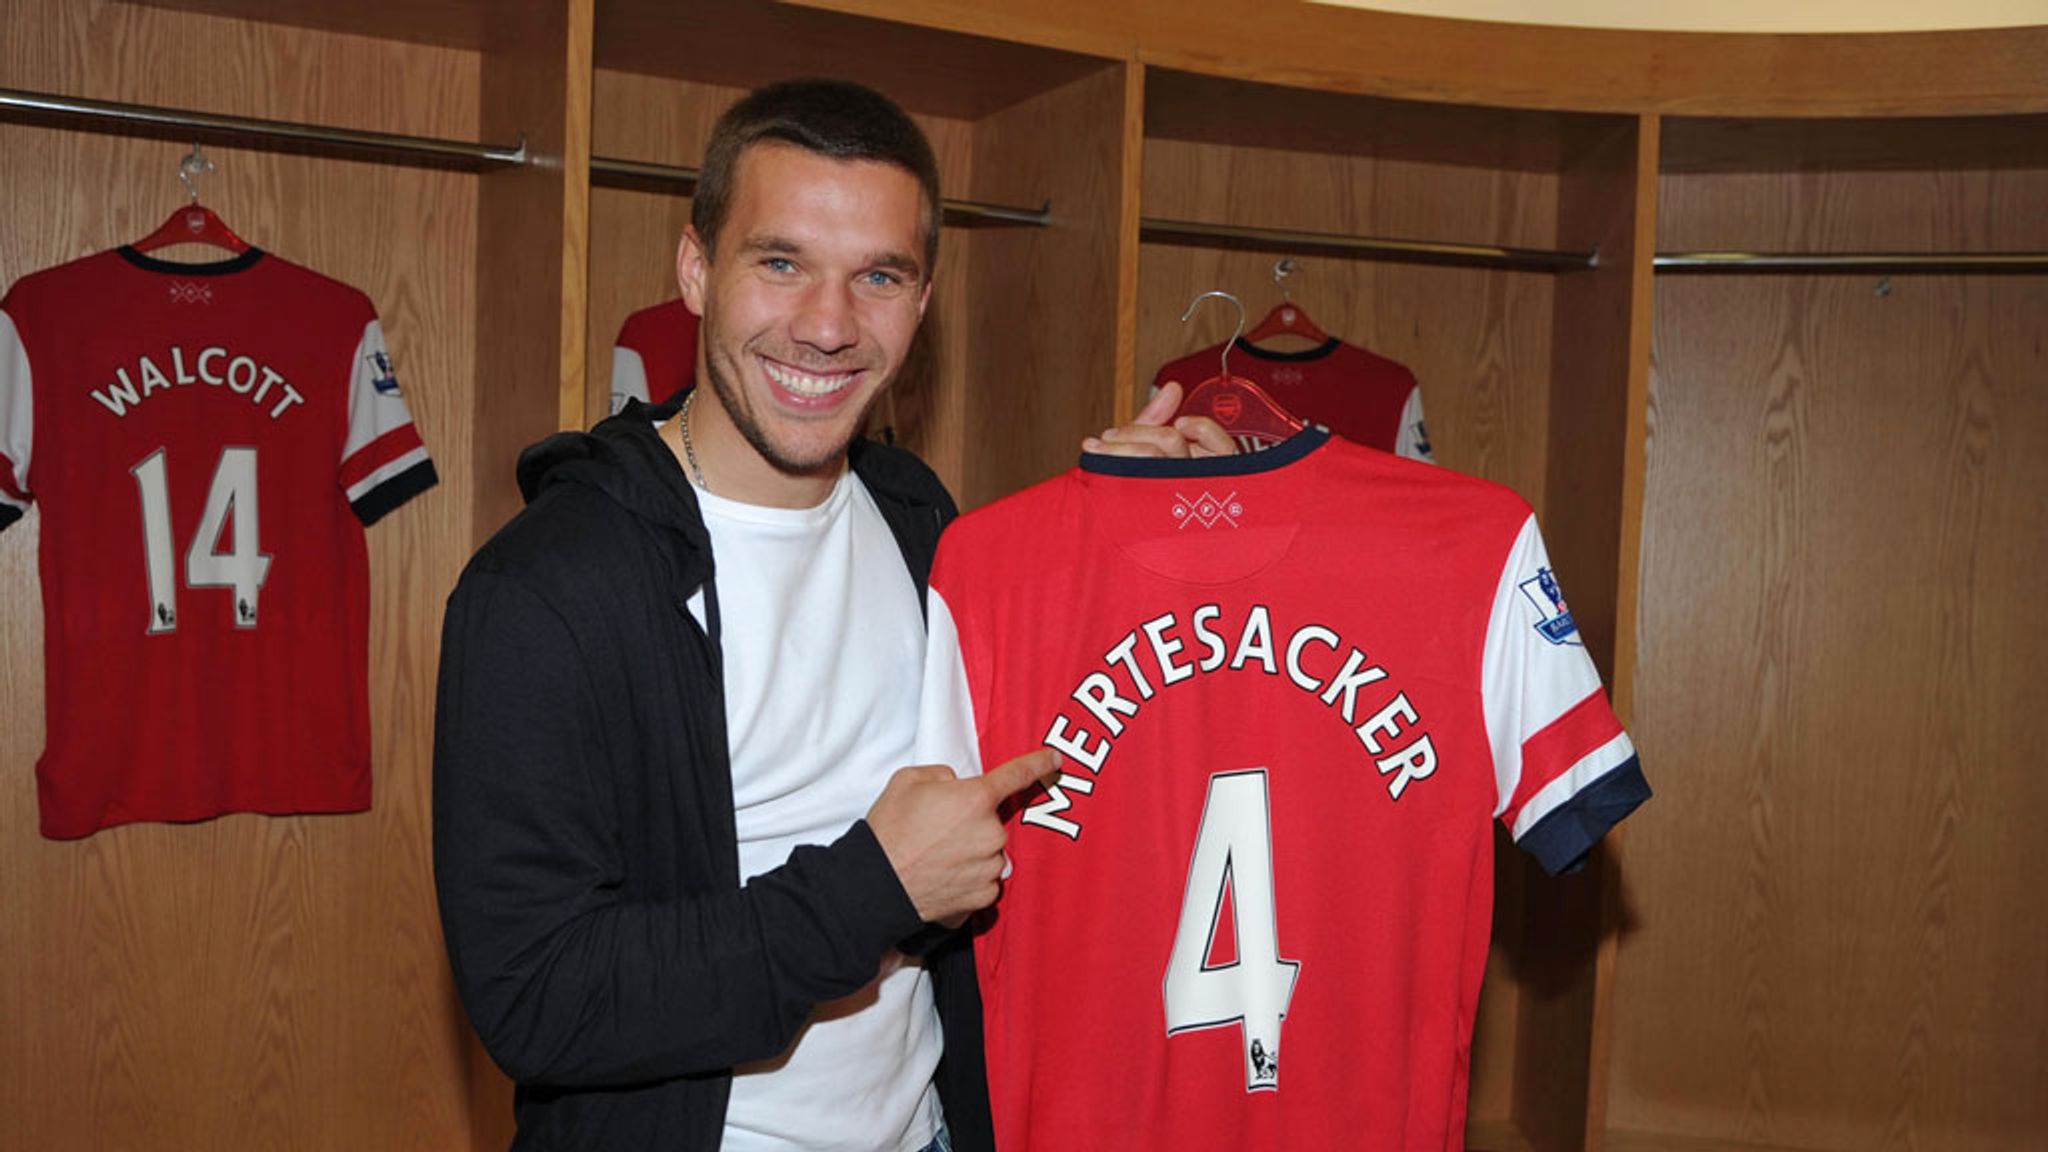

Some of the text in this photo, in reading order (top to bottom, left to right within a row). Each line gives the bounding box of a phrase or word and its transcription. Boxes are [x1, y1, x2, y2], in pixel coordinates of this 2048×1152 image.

[90, 346, 304, 419] WALCOTT
[130, 447, 273, 635] 14
[1021, 603, 1439, 840] MERTESACKER
[1162, 767, 1301, 1093] 4
